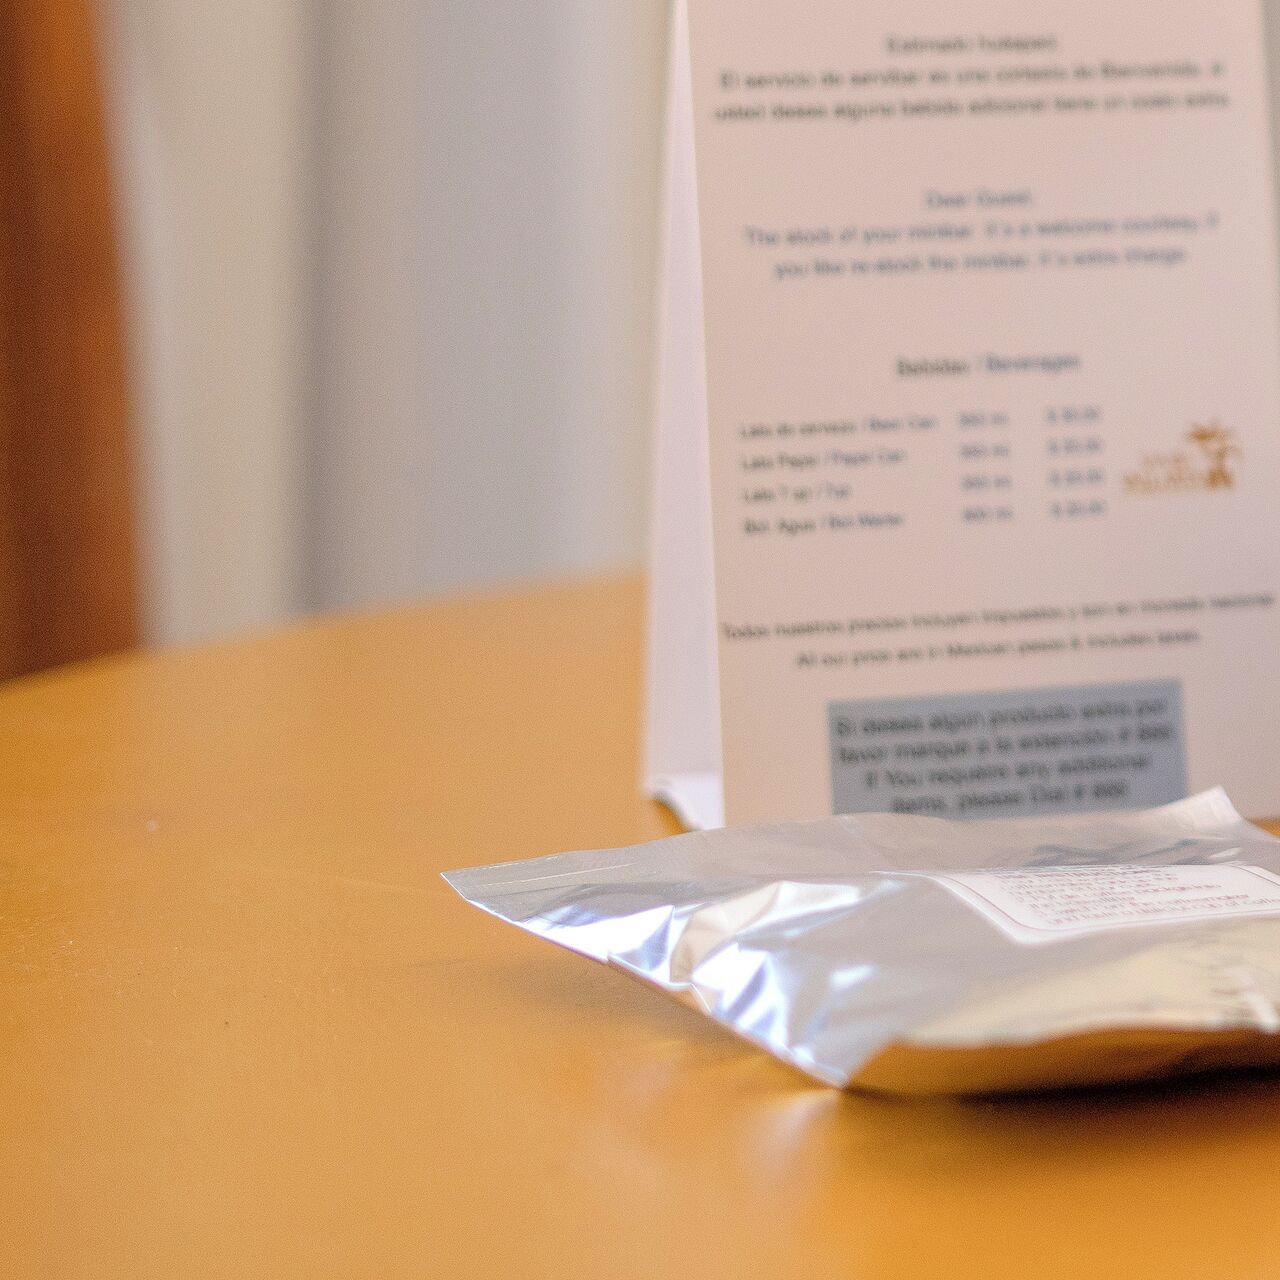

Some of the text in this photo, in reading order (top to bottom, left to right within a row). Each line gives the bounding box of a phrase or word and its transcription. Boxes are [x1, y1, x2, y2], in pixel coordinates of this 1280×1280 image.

[743, 70, 813, 89] servicio
[819, 69, 842, 88] de
[955, 69, 987, 84] una
[1073, 63, 1095, 82] de
[713, 102, 764, 122] usted
[833, 99, 893, 123] alguna
[899, 97, 961, 117] bebida
[967, 95, 1048, 116] adicional
[1102, 97, 1124, 112] un
[745, 229, 780, 248] The
[785, 226, 832, 246] stock
[862, 227, 901, 247] your
[1036, 216, 1113, 237] welcome
[773, 262, 806, 281] you
[812, 258, 844, 277] like
[928, 254, 956, 273] the
[896, 357, 968, 378] Bebidas
[986, 352, 1081, 378] Beverages
[721, 623, 768, 642] Todos
[773, 618, 841, 638] nuestros
[846, 614, 905, 637] precios
[911, 609, 977, 633] incluyen
[981, 604, 1063, 628] impuestos
[1082, 604, 1110, 619] son
[820, 654, 846, 669] our
[896, 649, 921, 664] are
[945, 640, 1011, 661] Mexican
[1016, 640, 1064, 659] pesos
[834, 718, 854, 739] Si
[859, 714, 922, 737] desea
[988, 704, 1074, 733] producto
[1082, 700, 1130, 723] extra
[1134, 702, 1166, 723] por
[838, 743, 887, 765] favor
[894, 741, 970, 765] marque
[996, 734, 1011, 754] la
[882, 767, 921, 789] You
[1015, 761, 1050, 783] any
[1057, 751, 1150, 776] additional
[956, 787, 1024, 813] please
